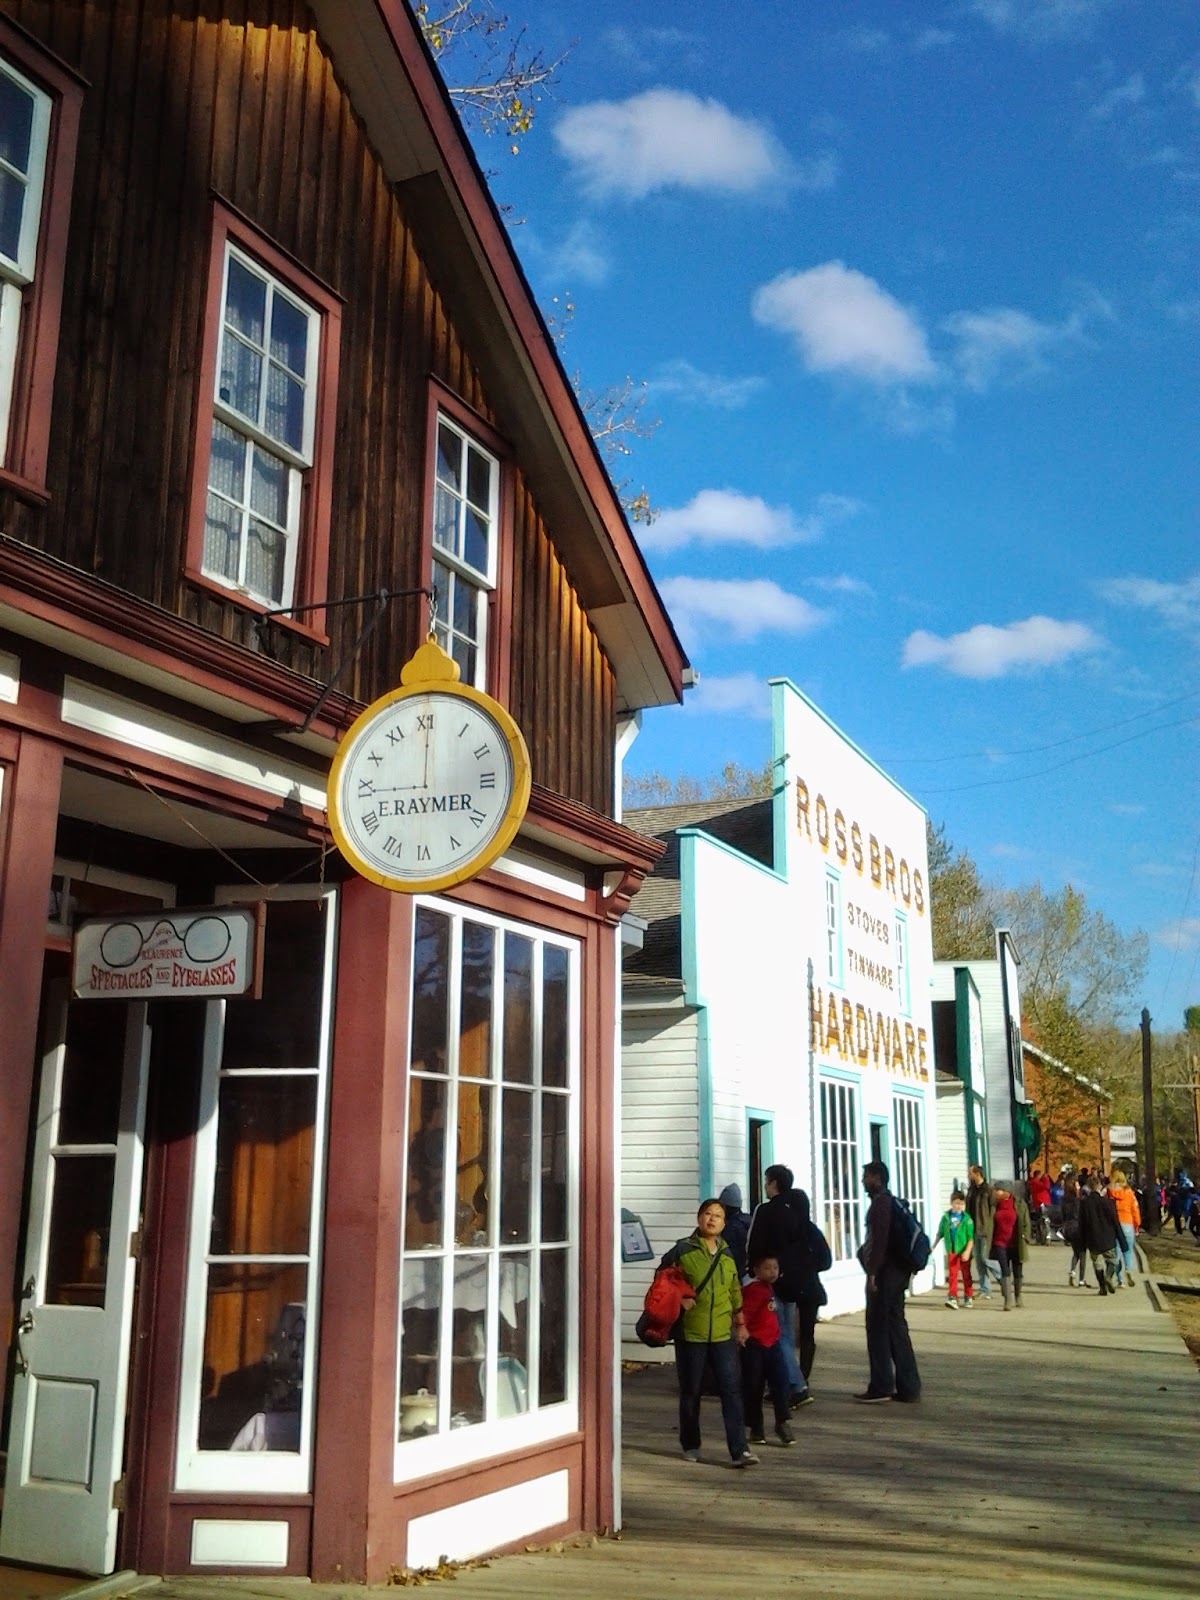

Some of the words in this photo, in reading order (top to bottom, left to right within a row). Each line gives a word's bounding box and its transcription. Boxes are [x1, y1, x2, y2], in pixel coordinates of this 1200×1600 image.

[416, 714, 434, 731] XI
[386, 726, 405, 746] XI
[367, 751, 383, 767] X
[473, 743, 491, 760] II
[480, 772, 495, 789] III
[847, 902, 889, 945] STOVES
[90, 963, 154, 990] SPECTACLES
[156, 970, 170, 981] AND
[171, 958, 237, 988] EYEGLASSES
[847, 948, 893, 991] TINWARE
[809, 984, 929, 1082] HARDWARE
